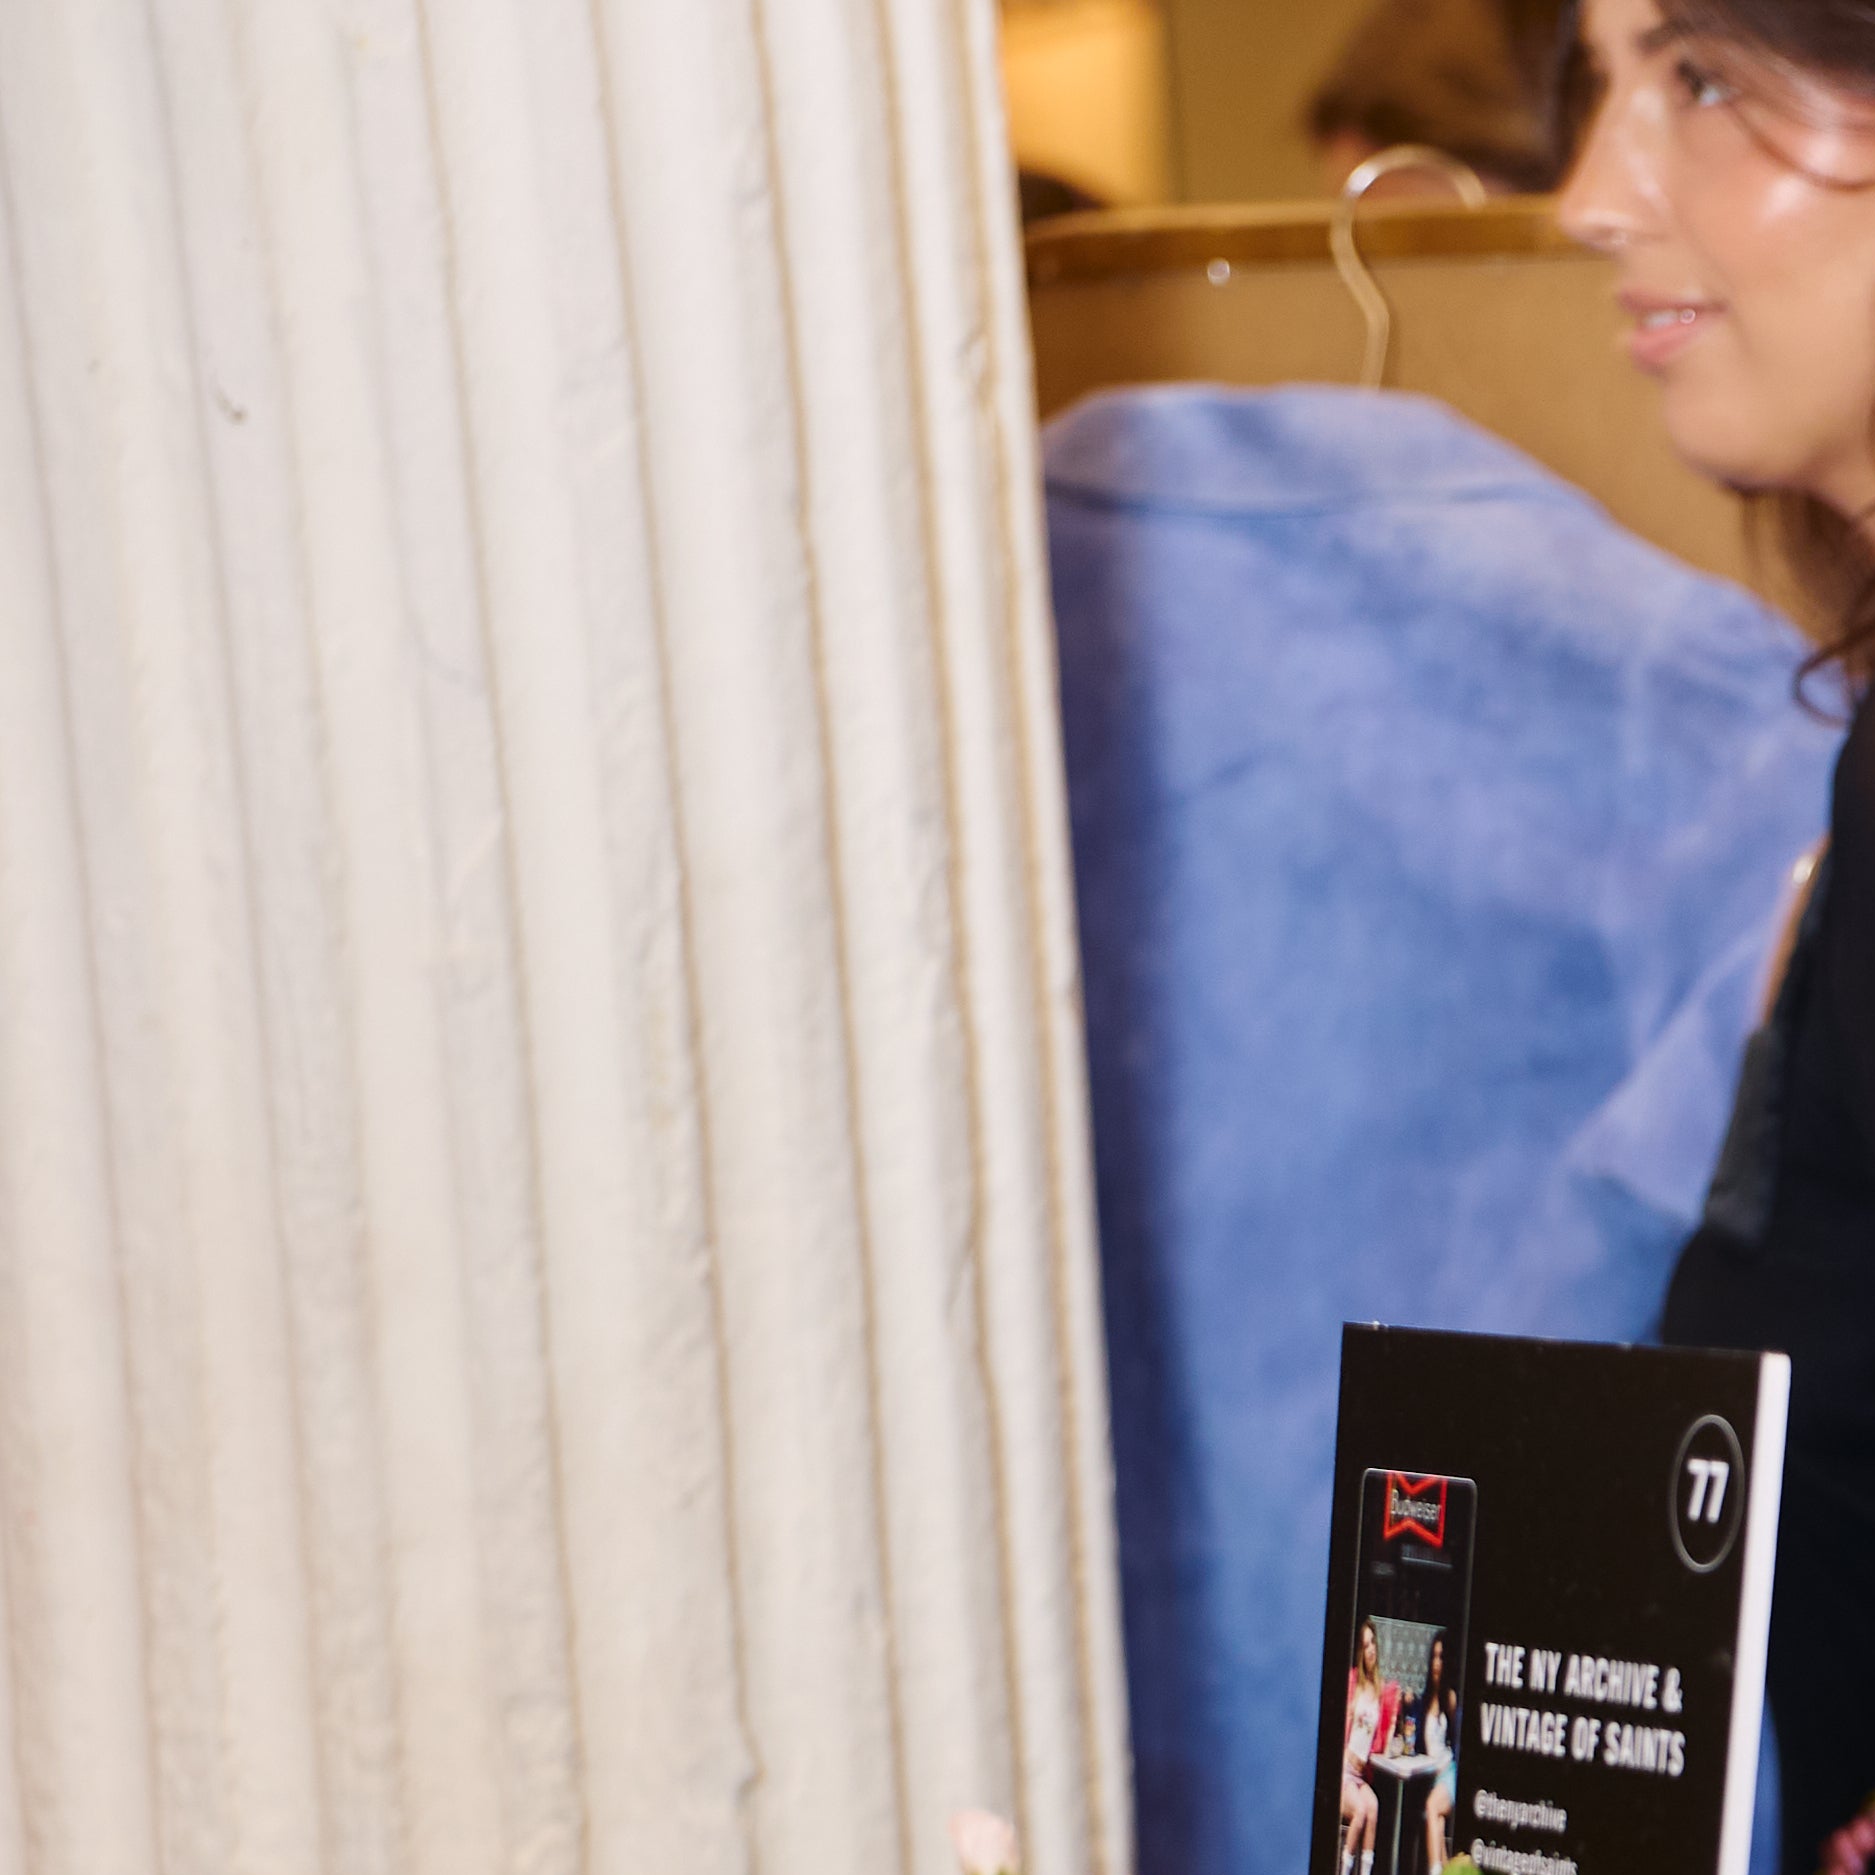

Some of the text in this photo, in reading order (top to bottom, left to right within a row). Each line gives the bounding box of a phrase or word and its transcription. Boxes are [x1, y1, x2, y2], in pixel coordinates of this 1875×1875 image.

[1687, 1458, 1730, 1524] 77
[1484, 1641, 1684, 1713] THE NY ARCHIVE &
[1479, 1702, 1687, 1777] VINTAGE OF SAINTS
[1473, 1788, 1567, 1833] @thenyarchive
